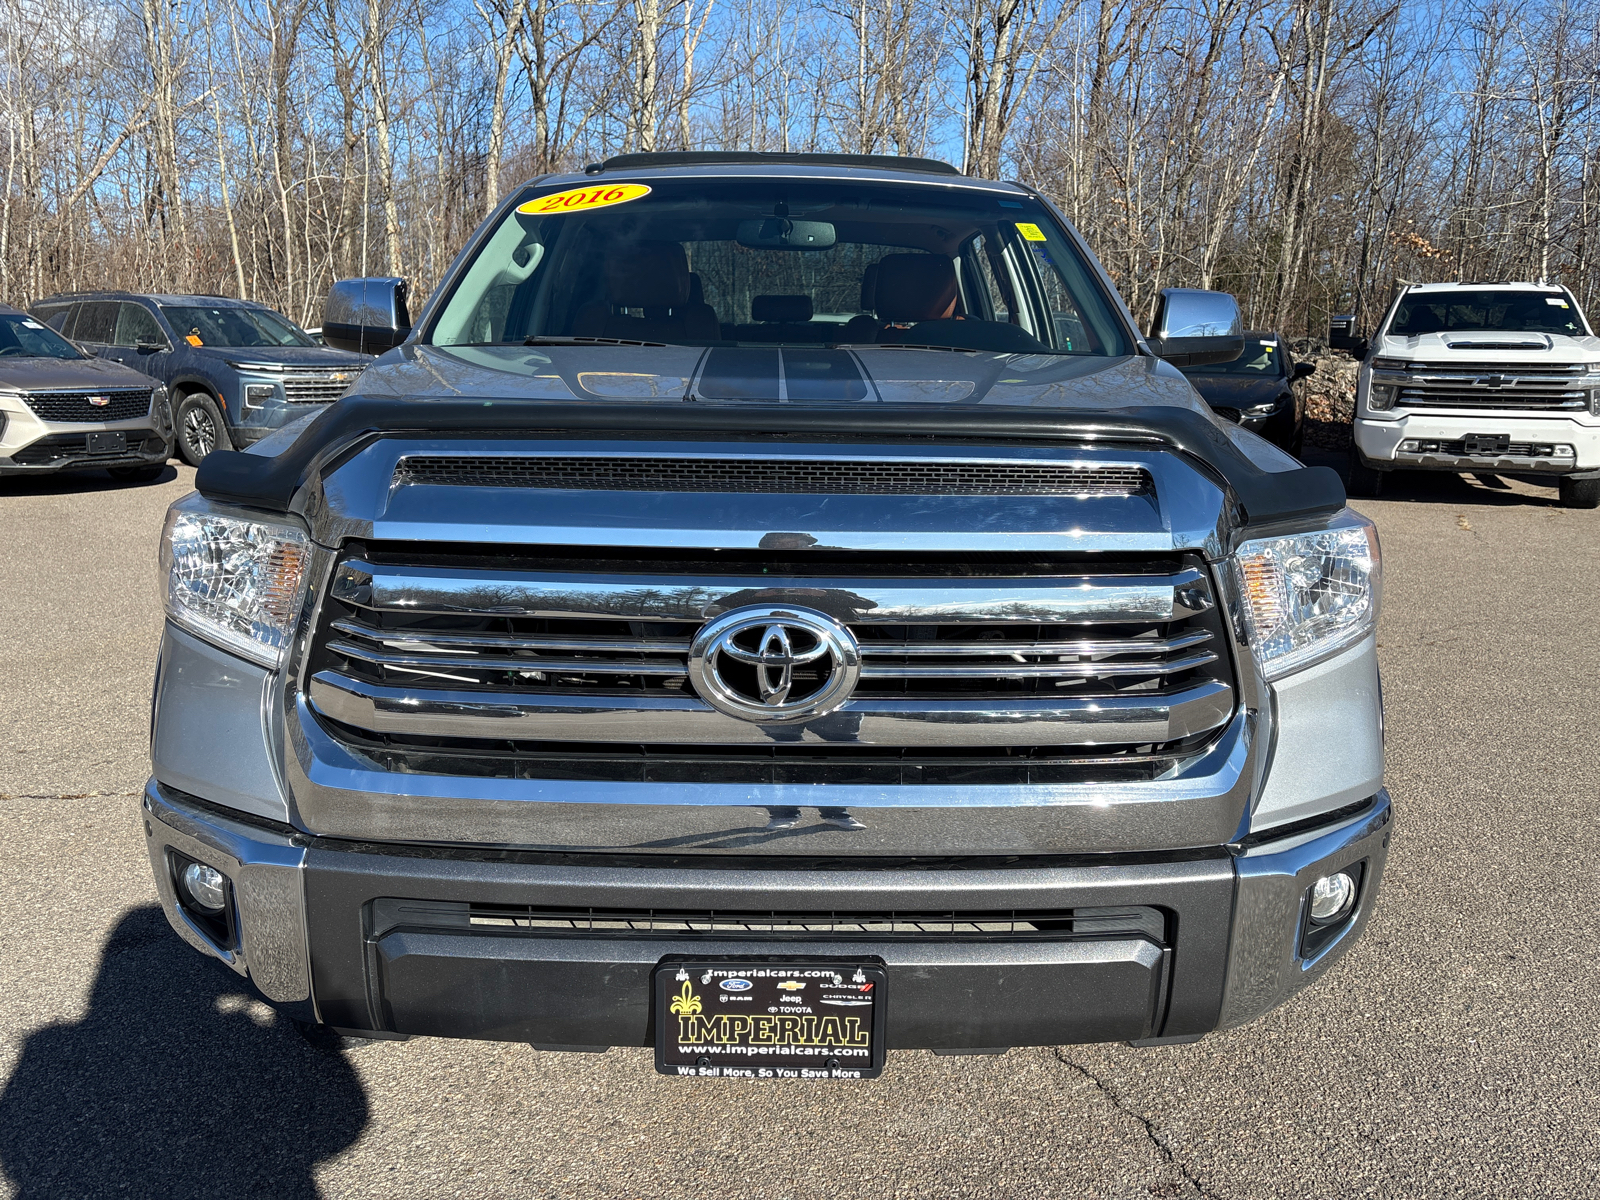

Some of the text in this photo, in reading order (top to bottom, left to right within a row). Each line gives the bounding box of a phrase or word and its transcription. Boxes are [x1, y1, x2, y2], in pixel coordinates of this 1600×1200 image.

[539, 186, 629, 212] 2016
[726, 981, 745, 990] Ford
[780, 995, 802, 1004] Jeep
[779, 1006, 812, 1014] TOYOTA
[678, 1014, 869, 1047] IMPERIAL
[678, 1044, 869, 1057] www.imperialcars.com
[677, 1066, 861, 1080] We Sell More, So You Save More
